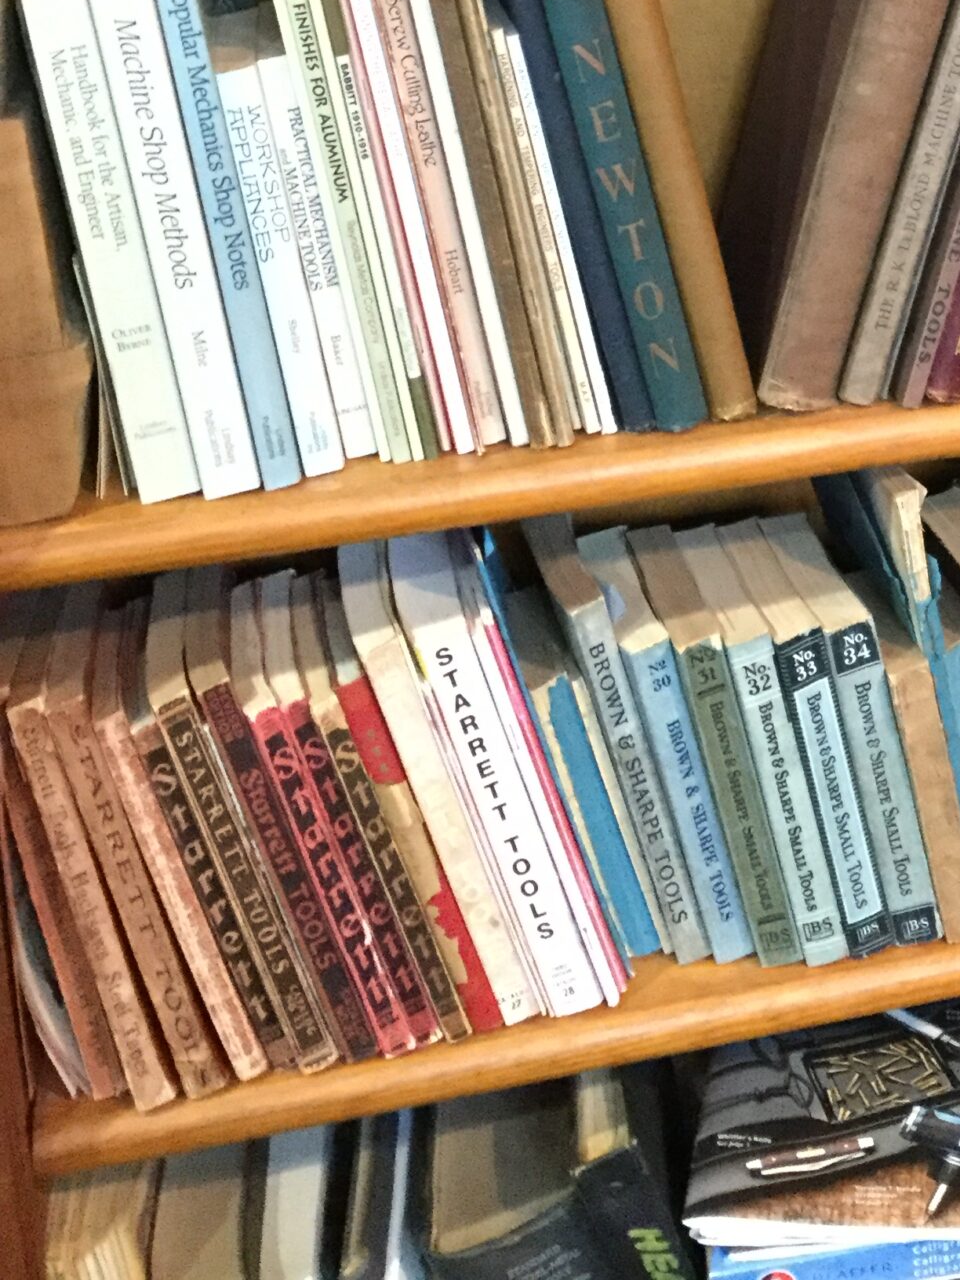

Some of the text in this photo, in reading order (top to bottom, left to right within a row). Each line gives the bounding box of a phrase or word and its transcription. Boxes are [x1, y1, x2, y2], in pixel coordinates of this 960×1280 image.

[70, 44, 130, 253] Handbook Artisan,
[187, 63, 223, 173] Mechanics
[293, 2, 349, 204] FINISHES FOR ALUMINUM
[340, 62, 370, 161] BABBITT 1910-1916
[923, 81, 958, 168] MACHINE
[113, 18, 194, 291] Machine Shop Methods
[211, 175, 236, 230] Shop
[227, 106, 275, 264] APPLIANCES
[247, 104, 291, 244] WORKSHOP
[76, 169, 105, 240] Engineer
[283, 165, 313, 244] MACHINE
[308, 192, 340, 289] MECHANISM
[569, 37, 681, 380] NEWTON
[223, 230, 250, 292] Notes
[443, 248, 464, 296] Hobart
[111, 324, 152, 341] OLIVER
[917, 282, 951, 365] TOOLS
[741, 661, 771, 680] No.
[747, 676, 774, 696] 32
[792, 649, 816, 667] No.
[795, 661, 818, 683] 33
[842, 631, 868, 649] No.
[843, 644, 872, 666] 34
[434, 646, 555, 941] STARRETT TOOLS
[588, 641, 689, 926] BROWN SHARPE TOOLS
[708, 699, 750, 822] BROWN SHARPE
[757, 700, 818, 913] BROWN SHARPE SMALL TOOLS
[806, 690, 869, 912] BROWN SHARPE SMALL TOOLS
[854, 679, 912, 899] BROWN SHARPE SMALL TOOLS
[176, 730, 290, 975] STARRETT TOOLS
[665, 718, 734, 924] BROWN SHARPE TOOLS
[561, 985, 576, 999] 28
